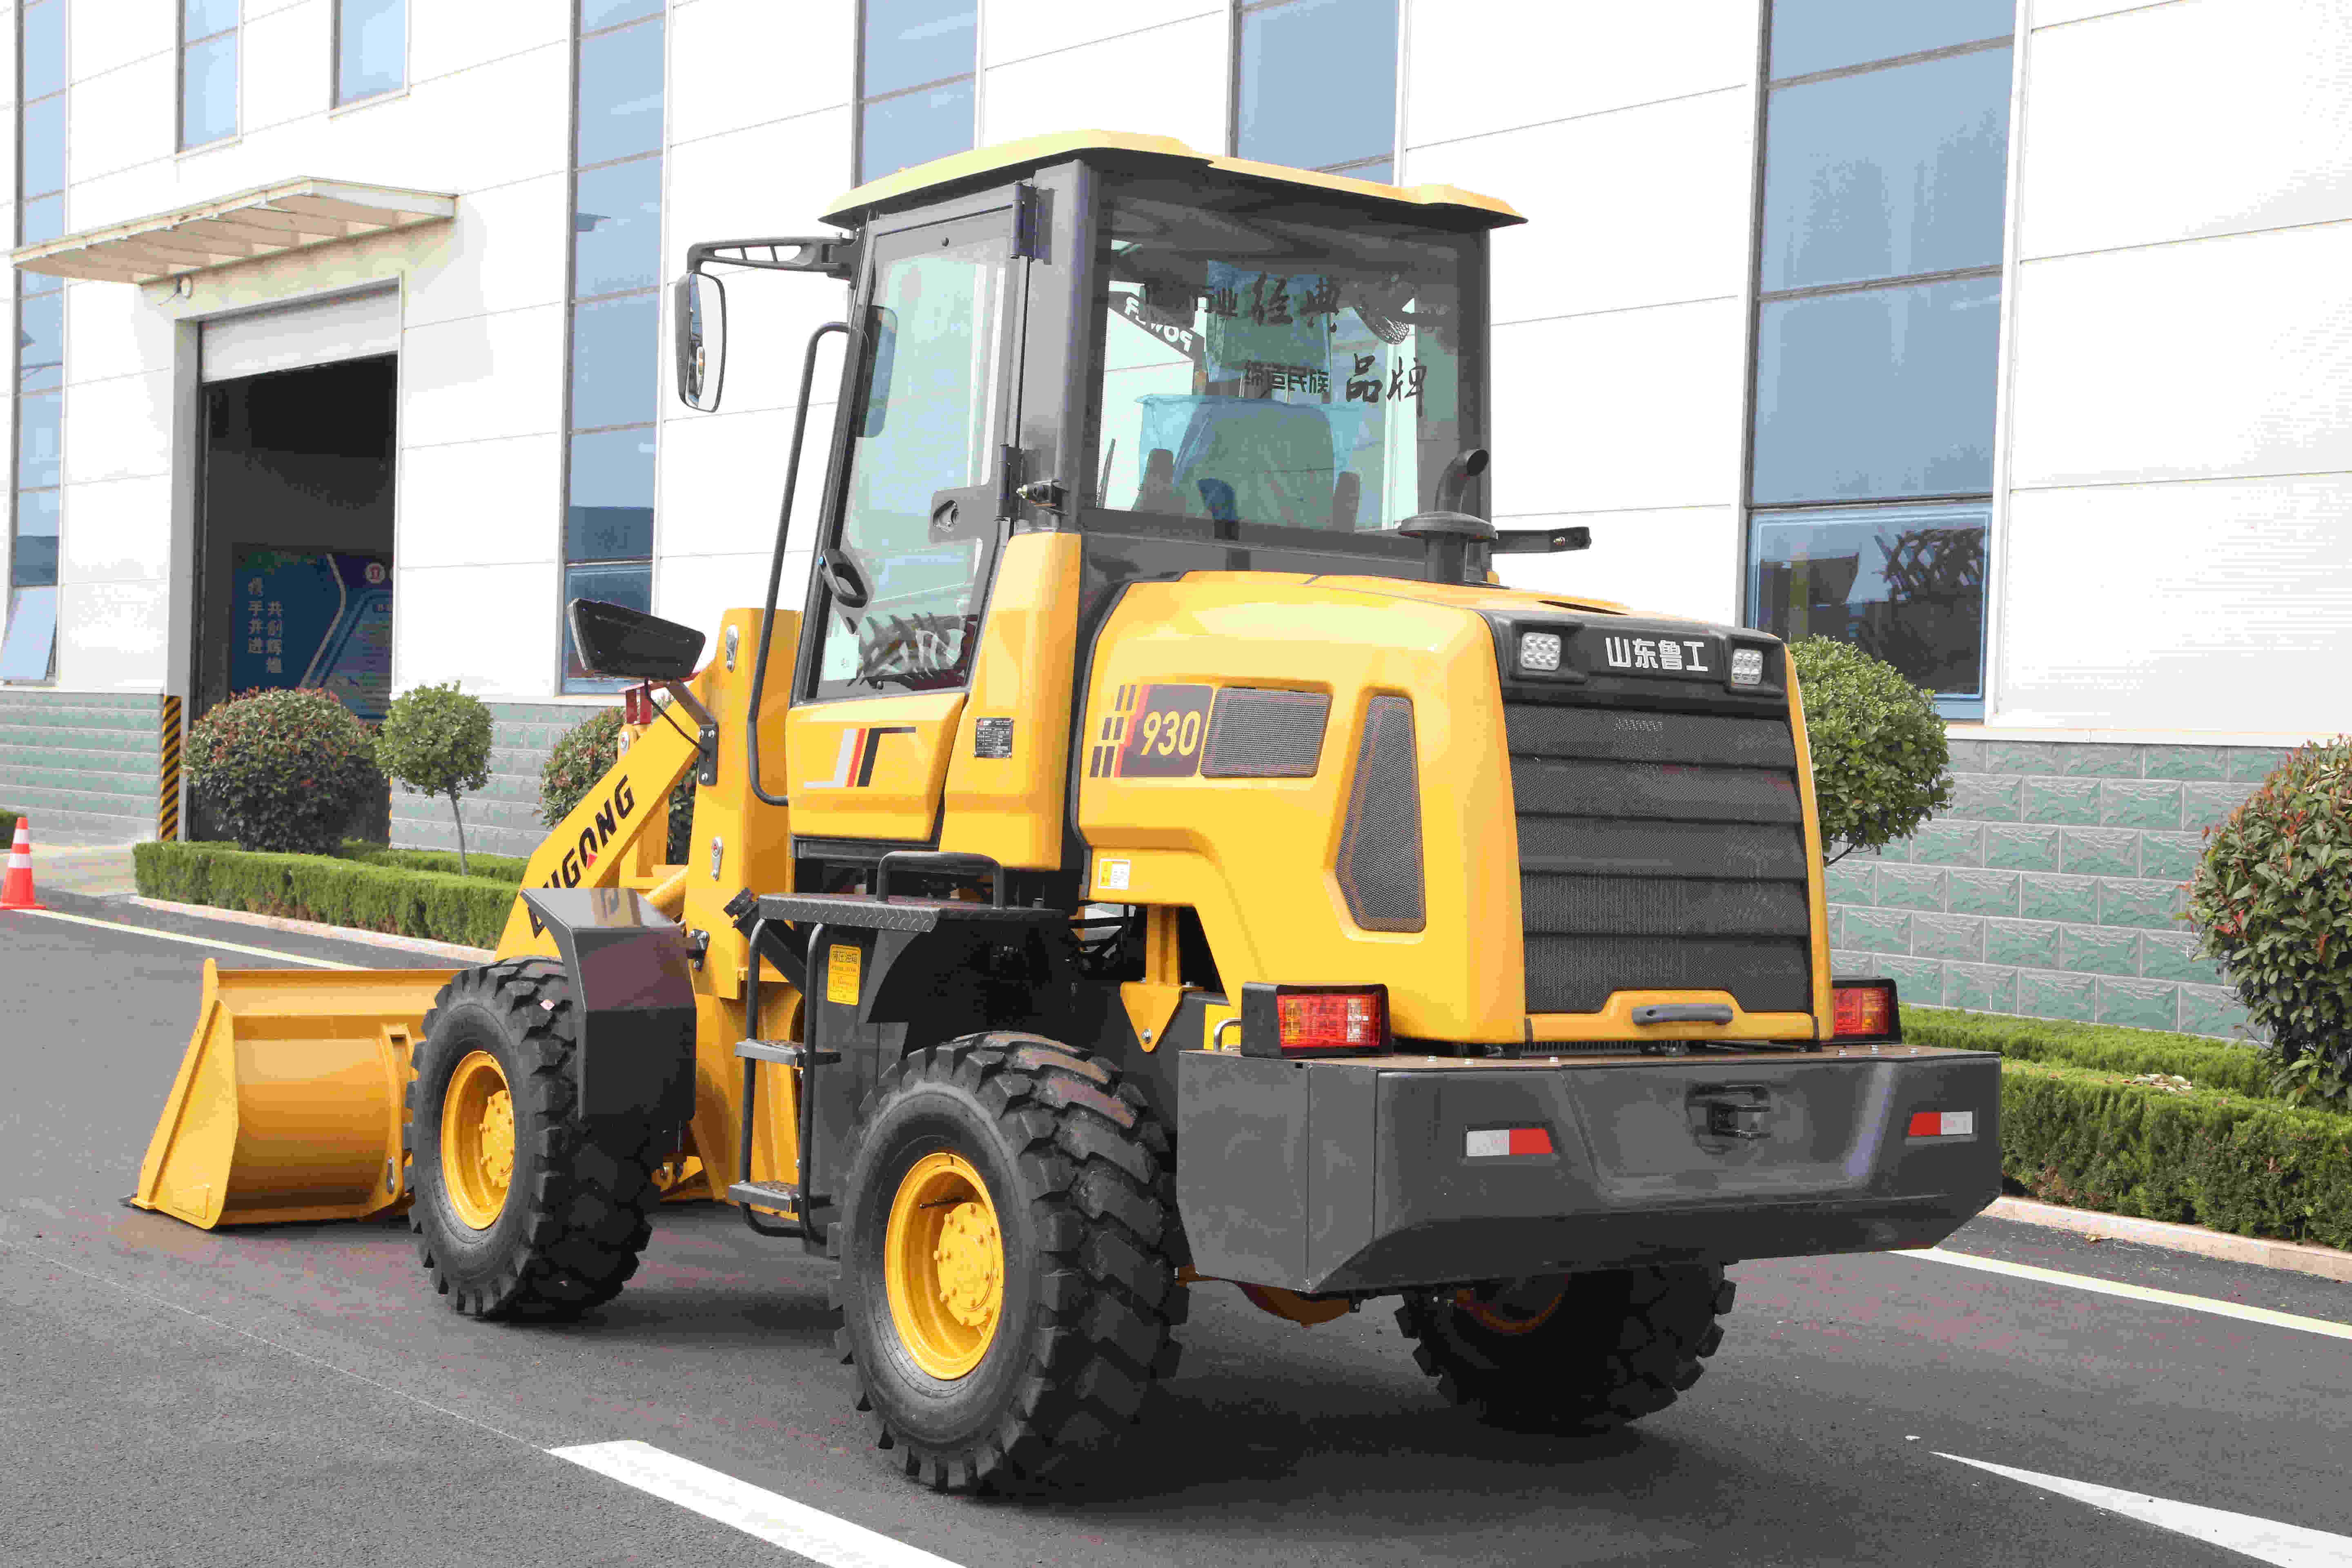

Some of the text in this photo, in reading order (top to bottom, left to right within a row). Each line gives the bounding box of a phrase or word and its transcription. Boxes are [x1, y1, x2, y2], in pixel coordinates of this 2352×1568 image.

[1605, 636, 1708, 672] 山东鲁工
[1140, 710, 1201, 756] 930
